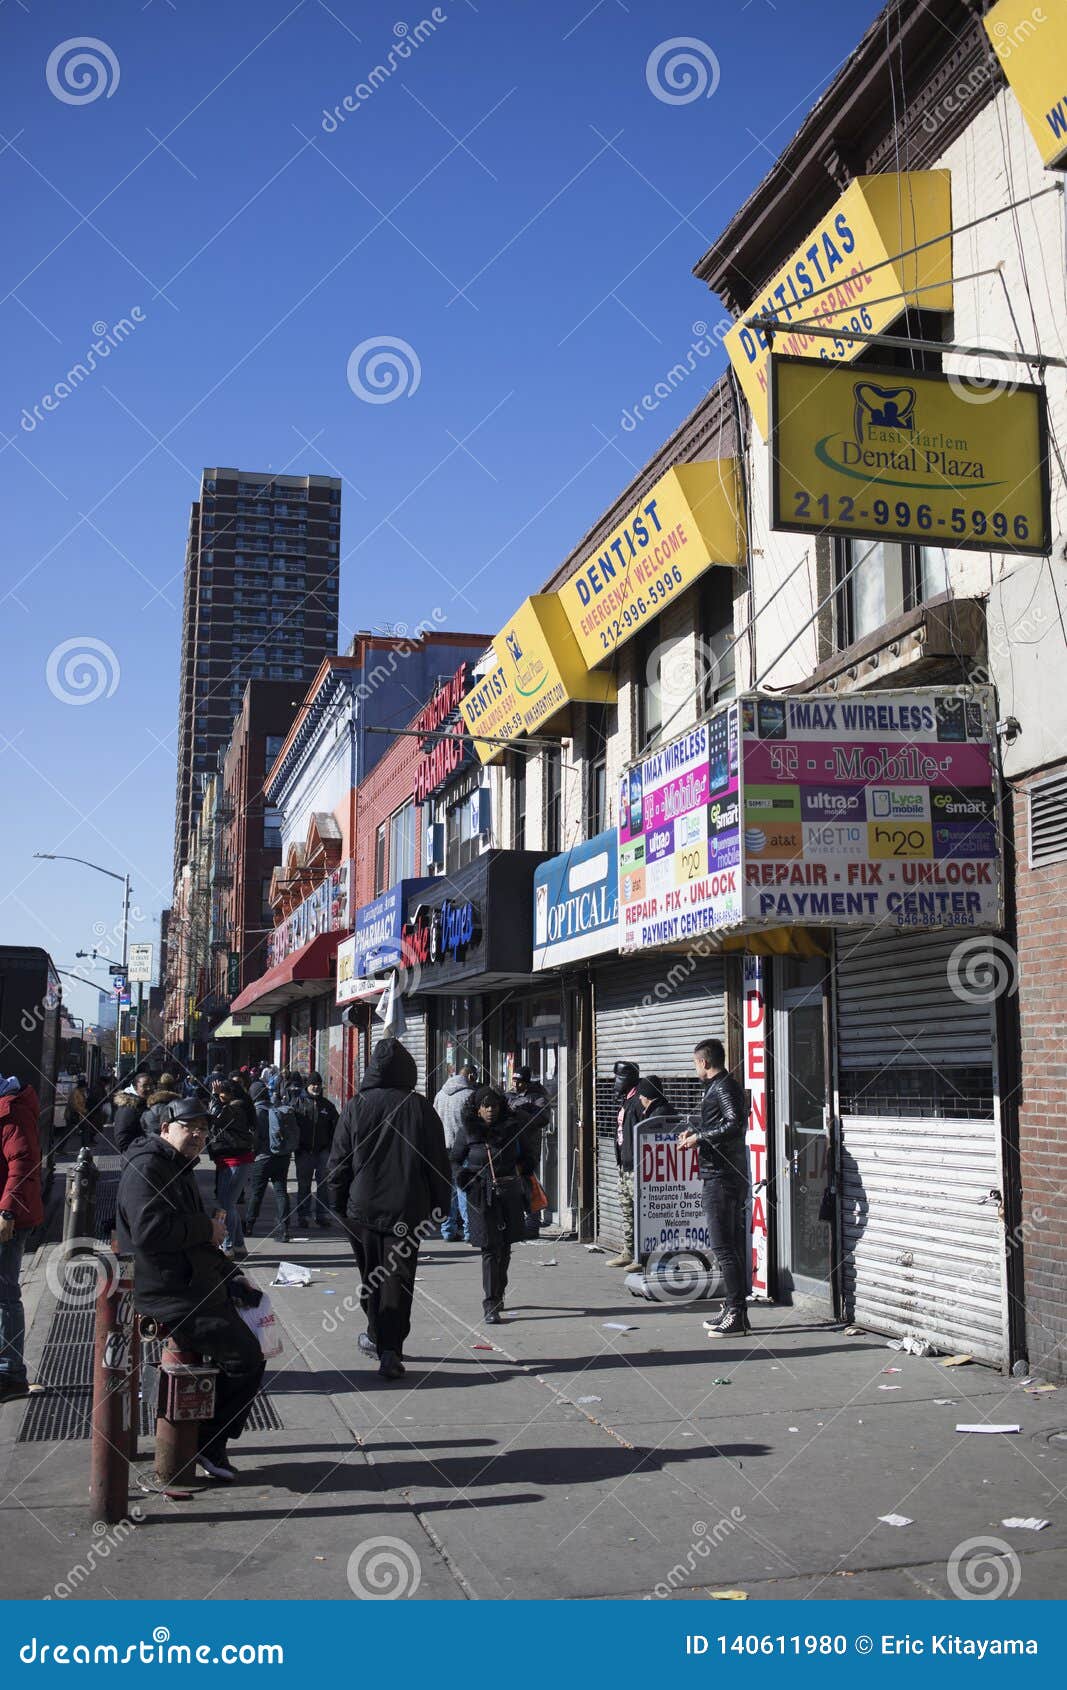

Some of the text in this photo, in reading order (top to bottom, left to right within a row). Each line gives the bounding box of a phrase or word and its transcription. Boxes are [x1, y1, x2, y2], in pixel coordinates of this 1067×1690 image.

[738, 213, 855, 364] DENTISTAS
[867, 425, 968, 451] East Harlem
[841, 441, 985, 479] Dental Plaza
[793, 491, 1030, 540] 212-996-5996
[575, 498, 663, 607] DENTIST
[580, 523, 689, 637] EMERGENCY WELCOME
[600, 564, 683, 649] 212-996-5996
[465, 666, 508, 724] DENTIST
[841, 704, 935, 731] WIRELESS
[664, 727, 707, 773] WIRELESS
[891, 791, 923, 806] Lyca
[891, 804, 924, 814] mobile
[945, 801, 988, 814] smart
[746, 862, 992, 887] REPAIR FIX UNLOCK
[547, 885, 611, 943] OPTICAL
[625, 898, 657, 926] REPAIR
[665, 889, 682, 912] FIX
[689, 870, 737, 905] UNLOCK
[759, 892, 879, 916] PAYMENT
[886, 891, 982, 915] CENTER
[355, 910, 397, 951] PHARMACY
[642, 916, 679, 945] PAYMENT
[680, 906, 715, 935] CENTER
[746, 989, 767, 1290] DENTAL
[642, 1144, 701, 1182] DENTA
[648, 1183, 686, 1193] Implants
[648, 1192, 679, 1201] Insurance
[649, 1201, 678, 1212] Repair
[679, 1200, 692, 1209] On
[664, 1219, 691, 1227] Welcome
